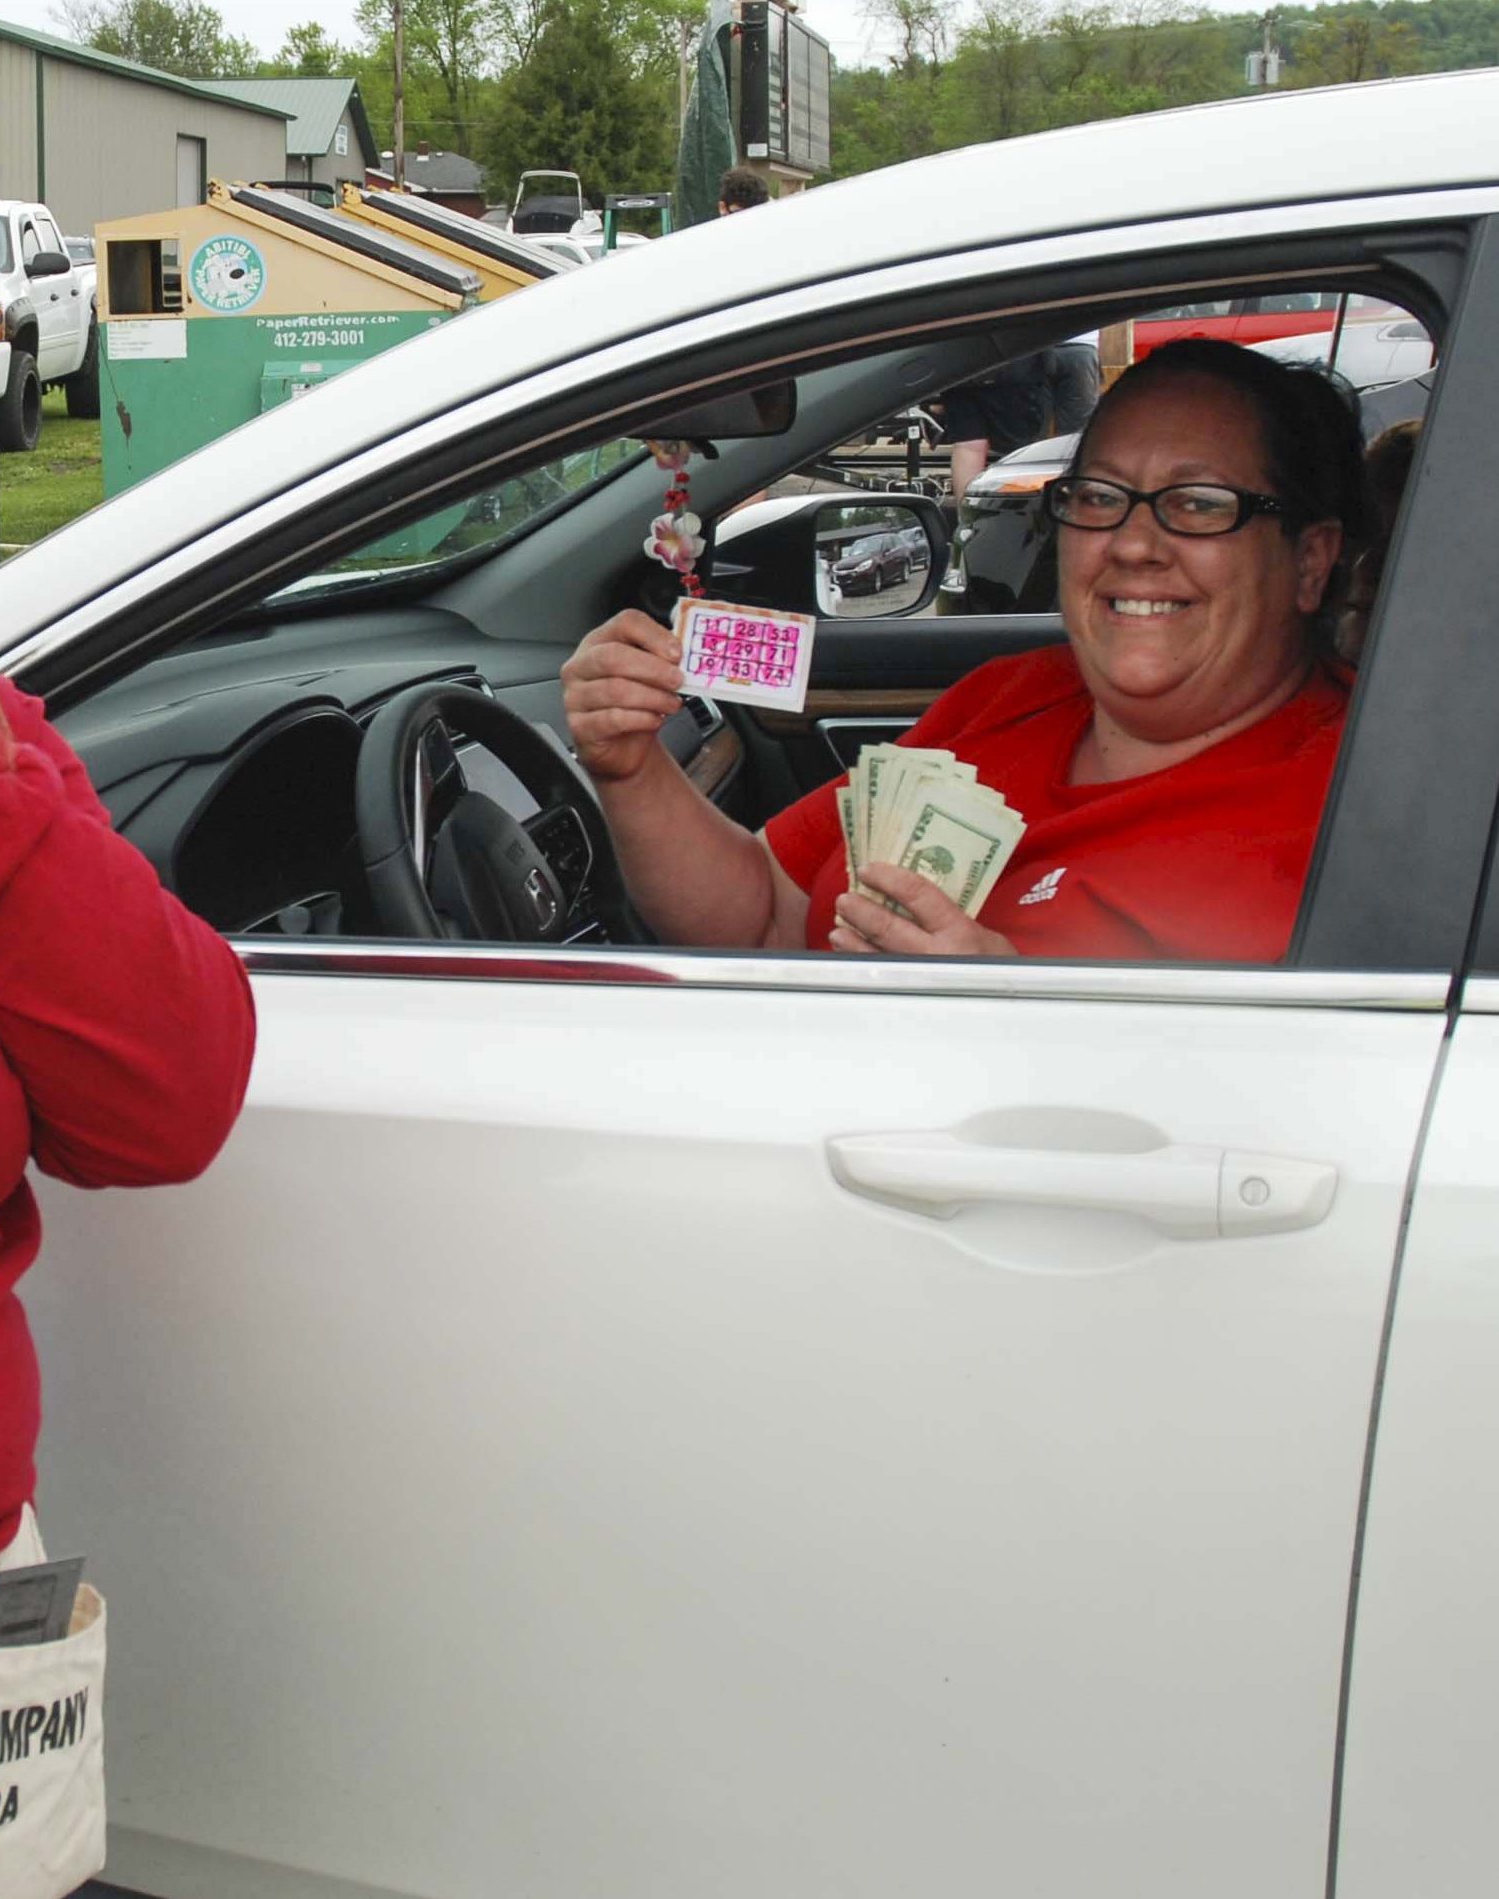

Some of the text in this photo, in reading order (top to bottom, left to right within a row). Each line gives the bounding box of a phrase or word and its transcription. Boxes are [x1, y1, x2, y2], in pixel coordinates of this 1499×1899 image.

[205, 240, 252, 259] ABITIBI
[274, 330, 364, 347] 412-279-3001
[736, 622, 757, 637] 28
[770, 628, 790, 642] 53
[734, 642, 754, 656] 29
[768, 646, 787, 661] 71
[731, 662, 751, 677] 43
[764, 667, 785, 681] 74
